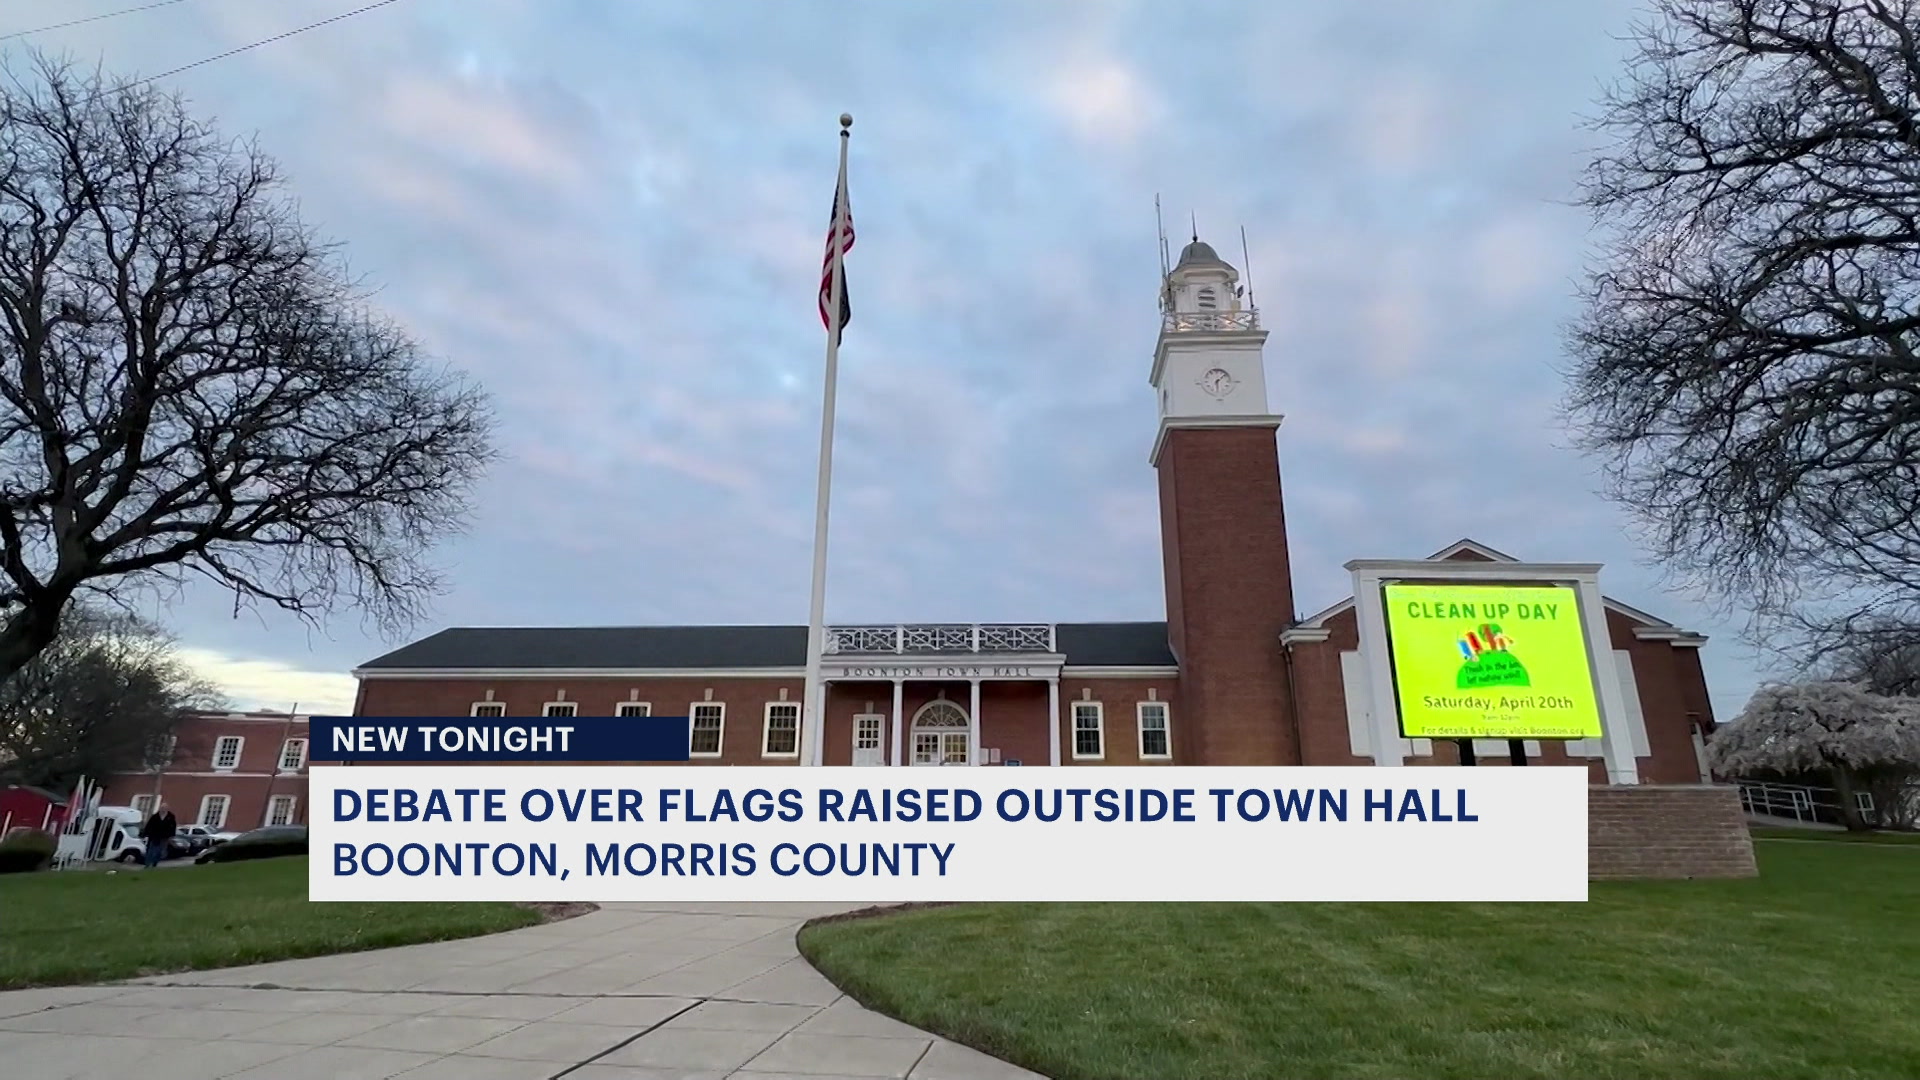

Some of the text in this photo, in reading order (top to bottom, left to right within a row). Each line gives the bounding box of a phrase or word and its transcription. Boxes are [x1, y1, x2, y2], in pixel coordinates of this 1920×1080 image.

[1407, 601, 1558, 620] CLEAN UP DAY
[1495, 662, 1507, 670] the
[843, 667, 1032, 678] BOONTON TOWN HALL
[1423, 696, 1574, 711] Saturday, April 20th
[1421, 726, 1436, 735] For
[1437, 726, 1468, 735] details
[1510, 726, 1528, 735] visit
